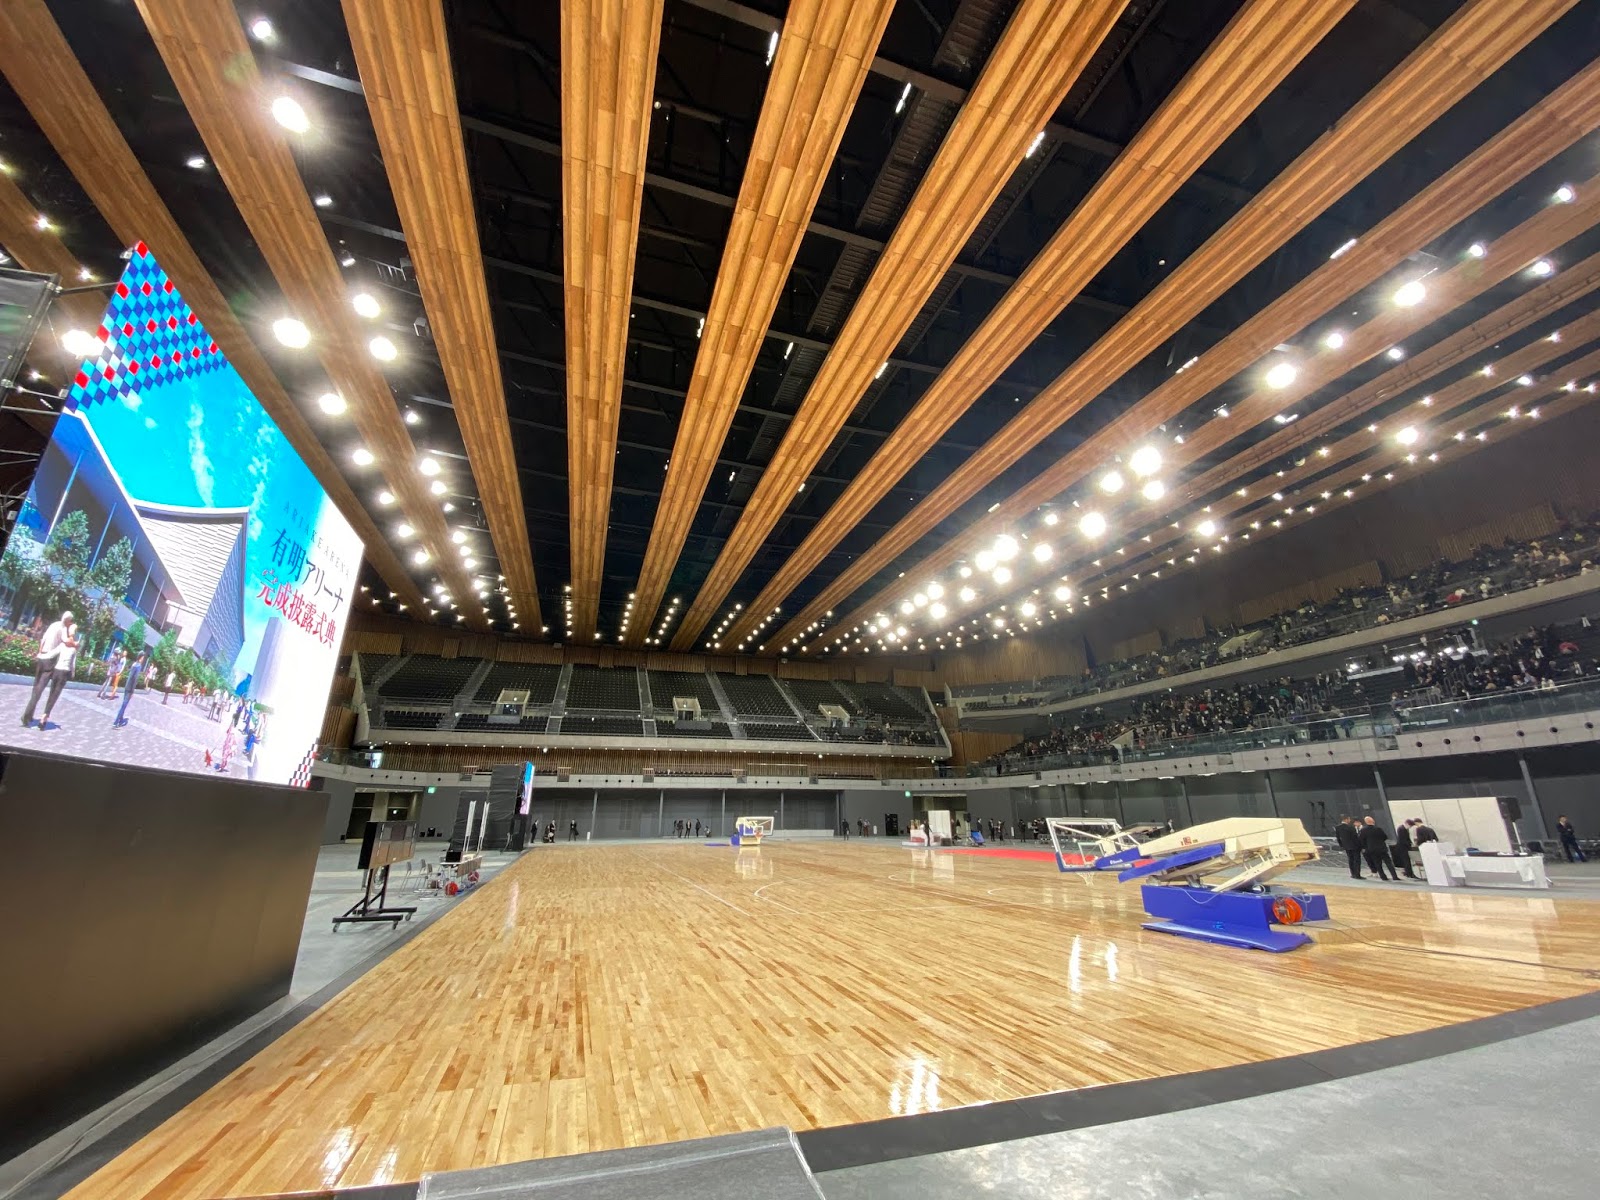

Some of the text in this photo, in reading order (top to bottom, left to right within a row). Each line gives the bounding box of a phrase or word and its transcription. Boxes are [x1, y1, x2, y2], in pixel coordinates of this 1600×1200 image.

[257, 568, 336, 648] 完成披露式典
[271, 528, 343, 613] 有明アリーナ
